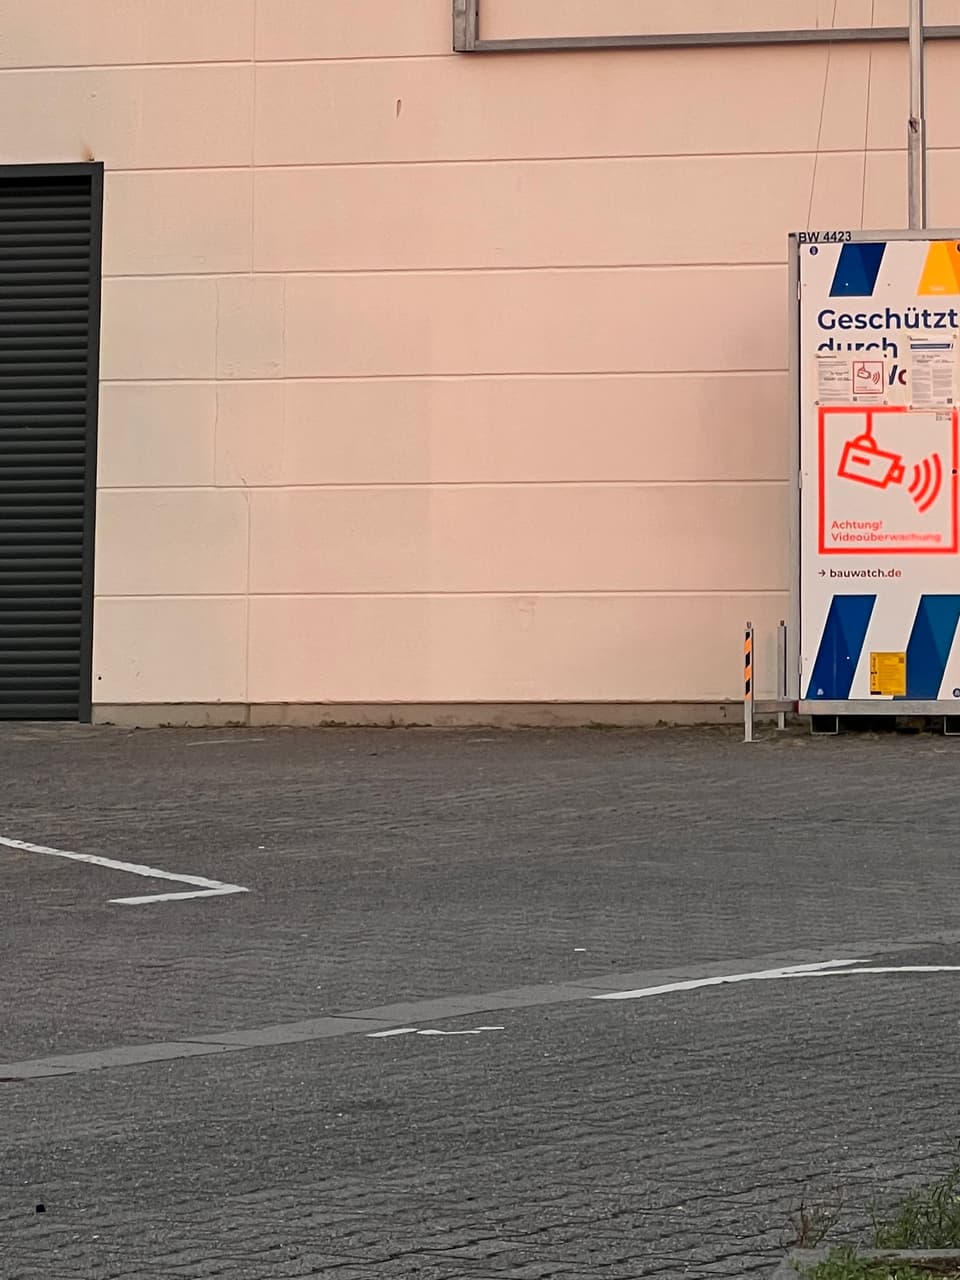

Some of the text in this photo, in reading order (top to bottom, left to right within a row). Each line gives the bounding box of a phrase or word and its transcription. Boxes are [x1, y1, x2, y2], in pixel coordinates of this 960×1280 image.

[799, 231, 852, 243] BW 4423
[817, 307, 959, 330] Geschützt
[831, 520, 883, 531] Achtung!
[829, 568, 902, 578] bauwatch.de
